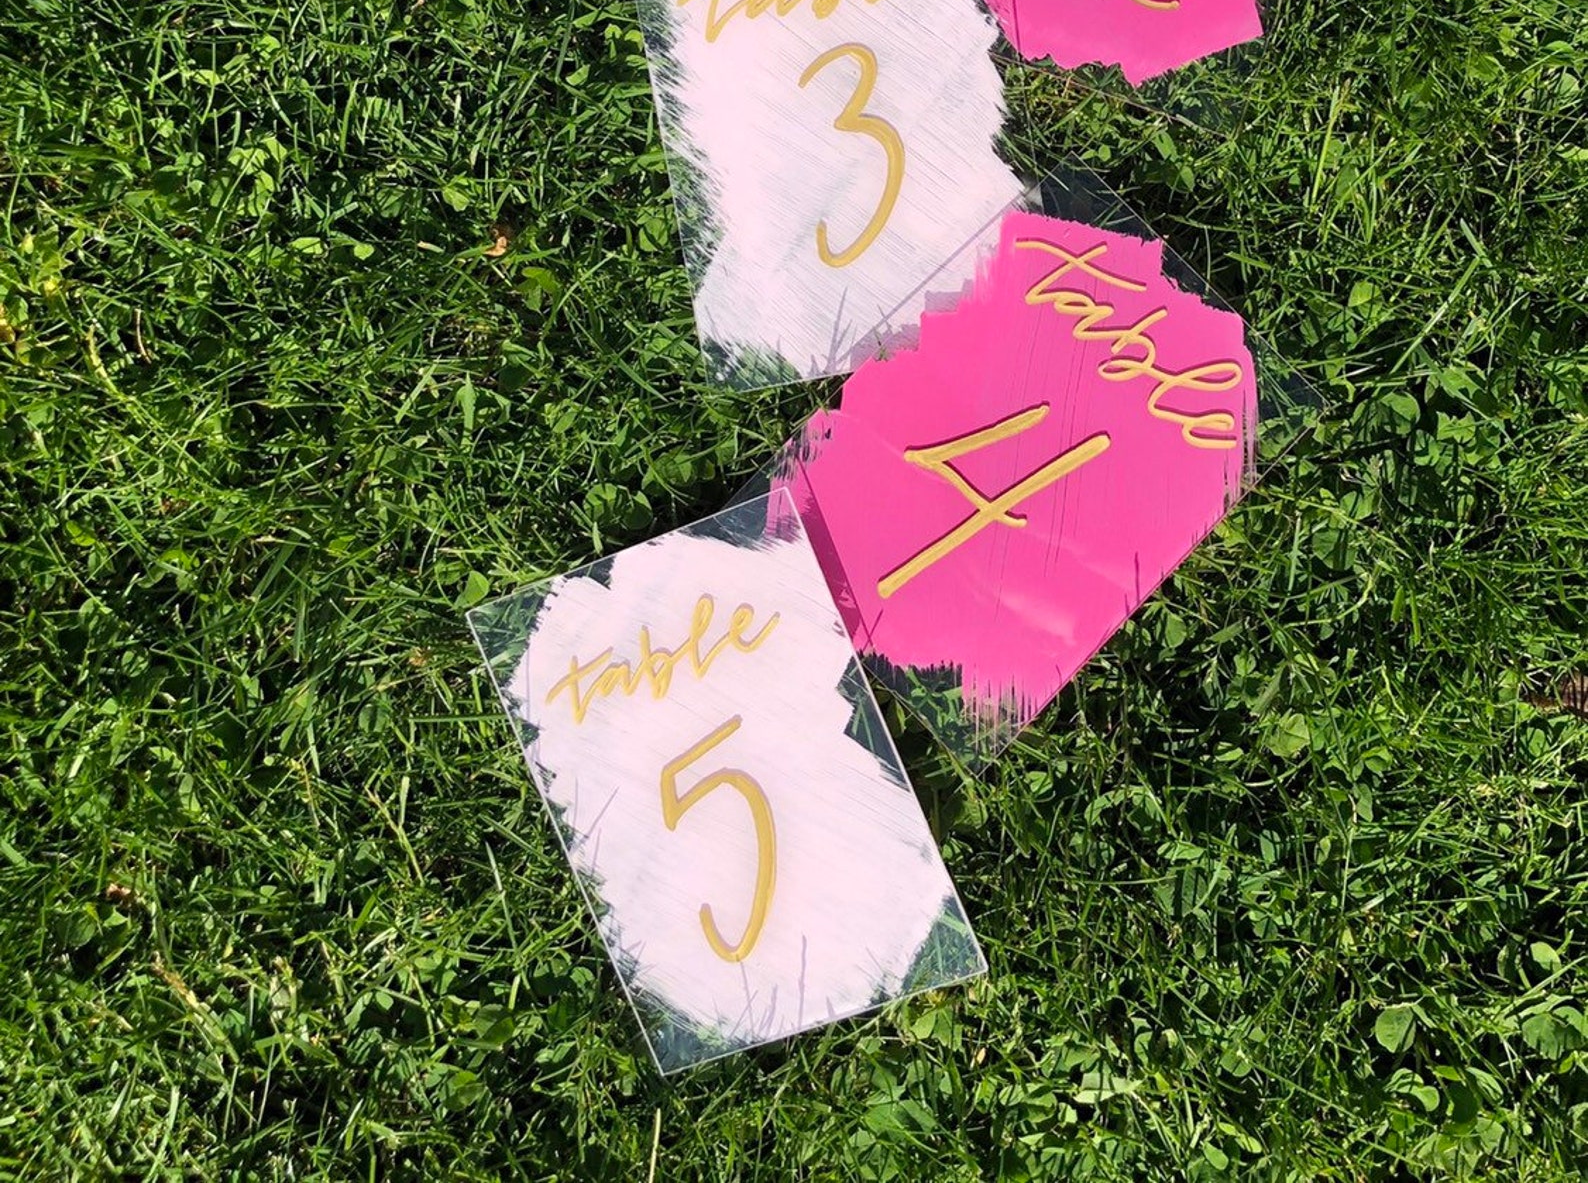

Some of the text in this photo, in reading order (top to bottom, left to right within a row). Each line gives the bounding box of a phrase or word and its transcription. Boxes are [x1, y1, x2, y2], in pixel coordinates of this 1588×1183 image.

[799, 43, 904, 267] 3
[1014, 237, 1243, 450] table
[877, 402, 1111, 599] 4
[546, 594, 780, 725] table
[660, 715, 776, 963] 5
